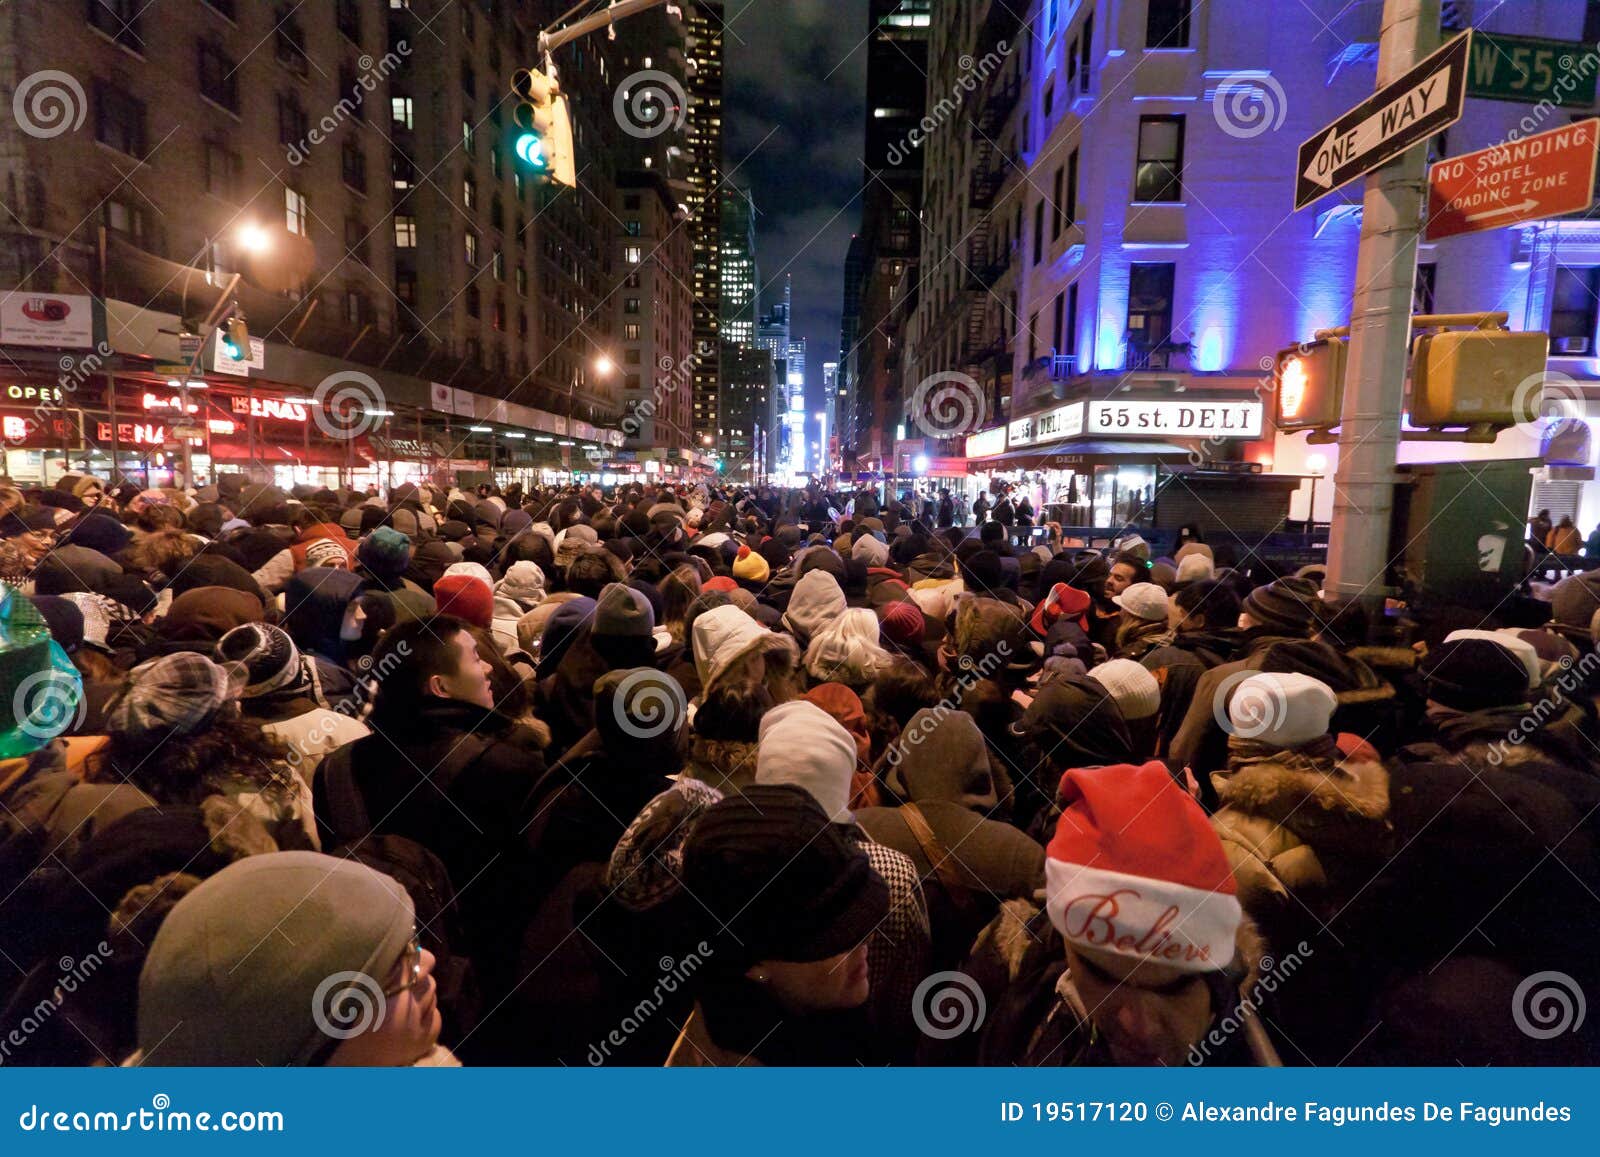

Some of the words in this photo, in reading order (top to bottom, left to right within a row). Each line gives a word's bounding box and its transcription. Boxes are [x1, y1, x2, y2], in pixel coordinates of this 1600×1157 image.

[1473, 43, 1500, 86] W
[1509, 47, 1553, 91] 55
[1317, 130, 1359, 176] ONE
[1379, 78, 1438, 139] WAY
[1437, 162, 1465, 183] NO
[1476, 127, 1587, 172] STANDING
[1476, 164, 1536, 188] HOTEL
[1520, 171, 1569, 194] ZONE
[1039, 413, 1061, 435] DELI
[1099, 408, 1130, 427] 55
[1138, 409, 1168, 428] st.
[1177, 408, 1250, 429] DELI
[1055, 455, 1083, 464] DELI
[1064, 889, 1211, 962] Believe
